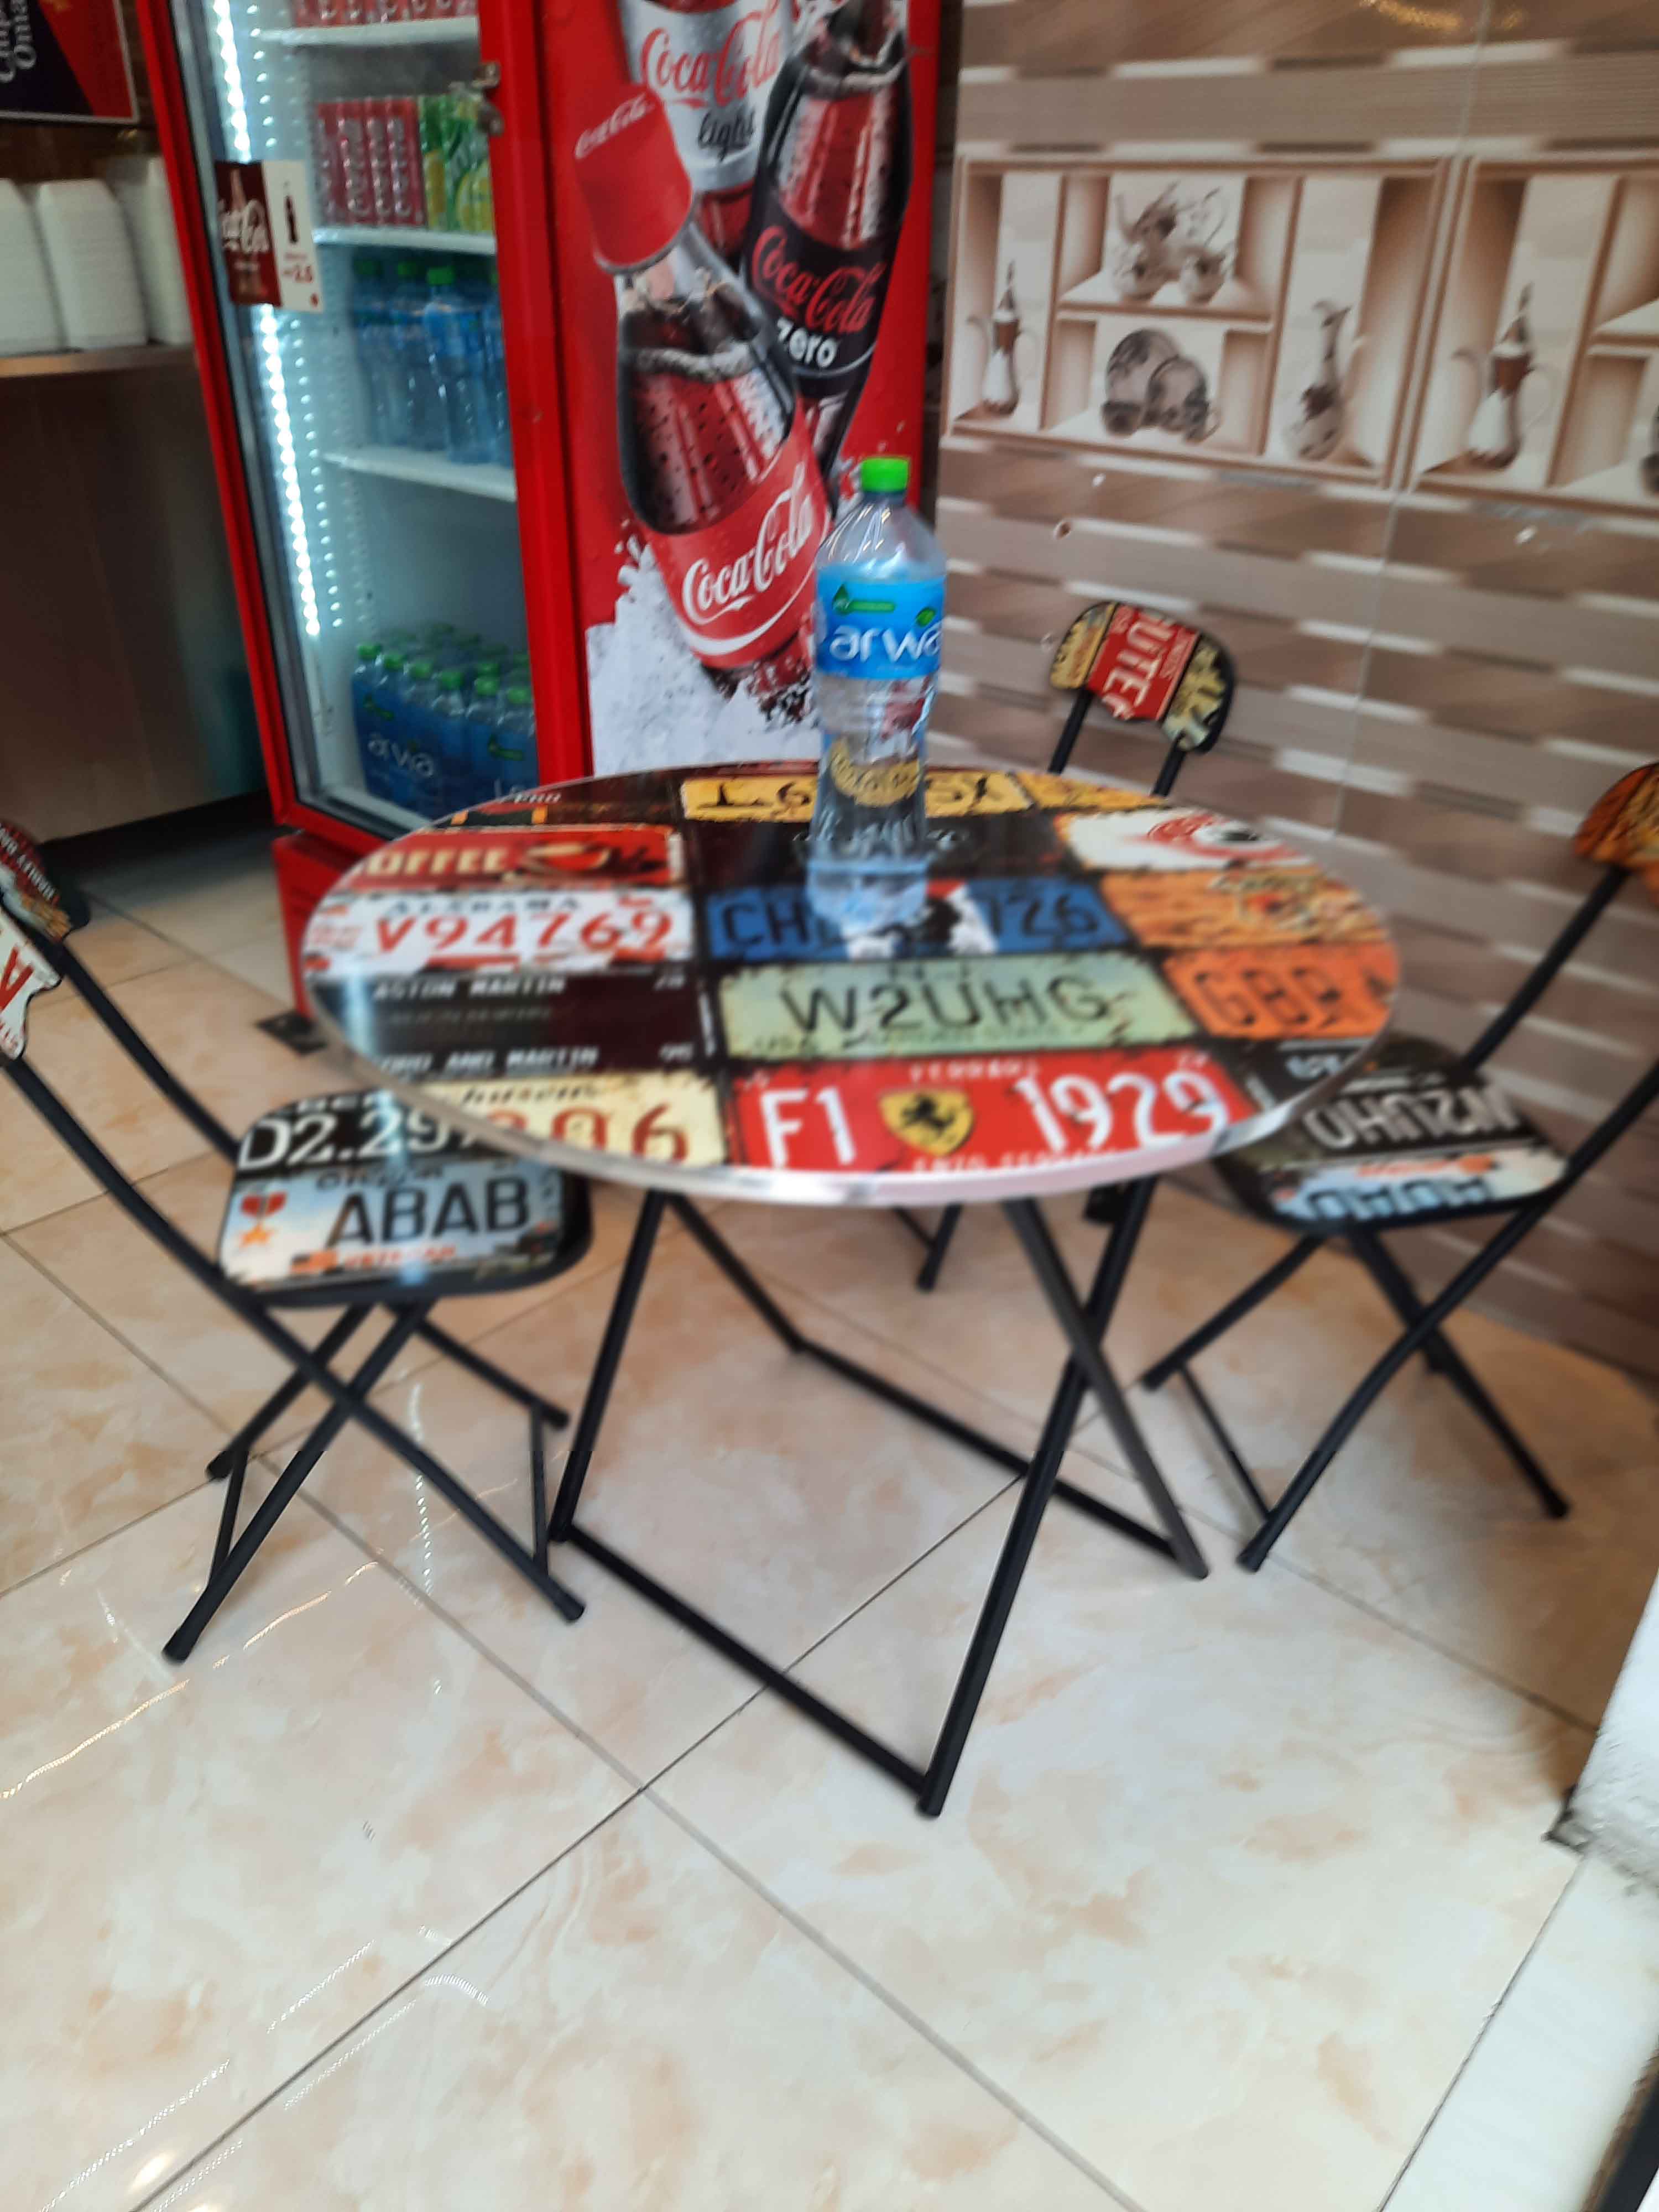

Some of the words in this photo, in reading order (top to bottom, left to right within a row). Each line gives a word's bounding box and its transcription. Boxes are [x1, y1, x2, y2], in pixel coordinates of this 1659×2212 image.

[375, 912, 674, 953] V94769
[1013, 1072, 1230, 1156] 1929
[325, 1177, 530, 1250] ABAB
